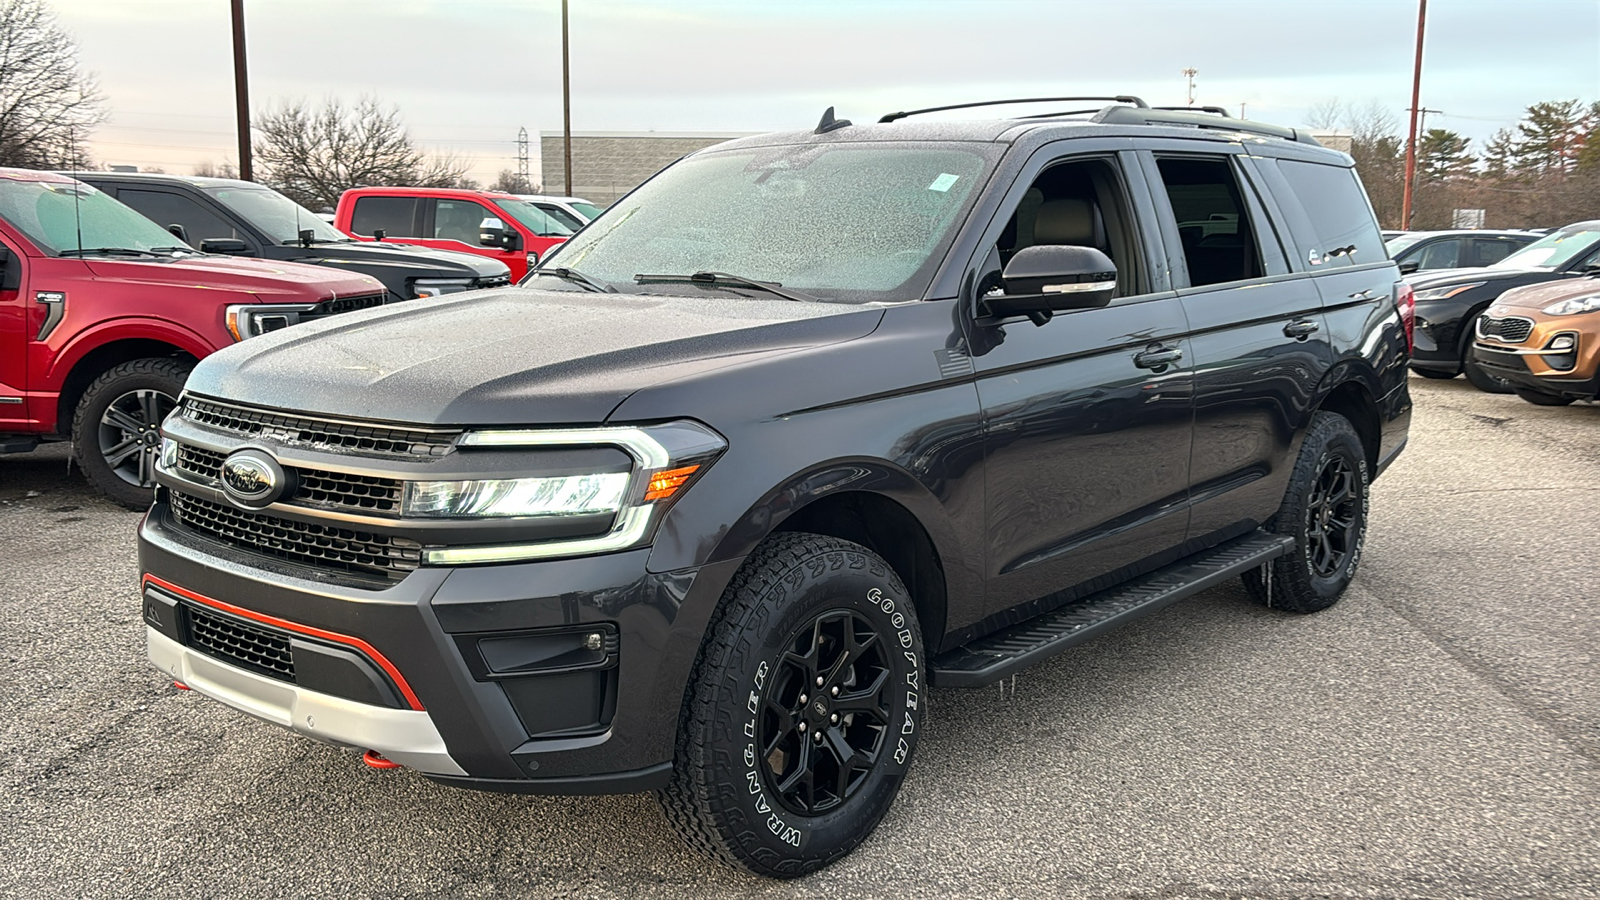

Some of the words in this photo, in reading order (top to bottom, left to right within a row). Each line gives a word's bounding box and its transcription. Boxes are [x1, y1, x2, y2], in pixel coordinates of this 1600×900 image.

[227, 463, 260, 490] Ford
[743, 661, 801, 847] WRANGLER
[867, 587, 919, 765] GOODYEAR
